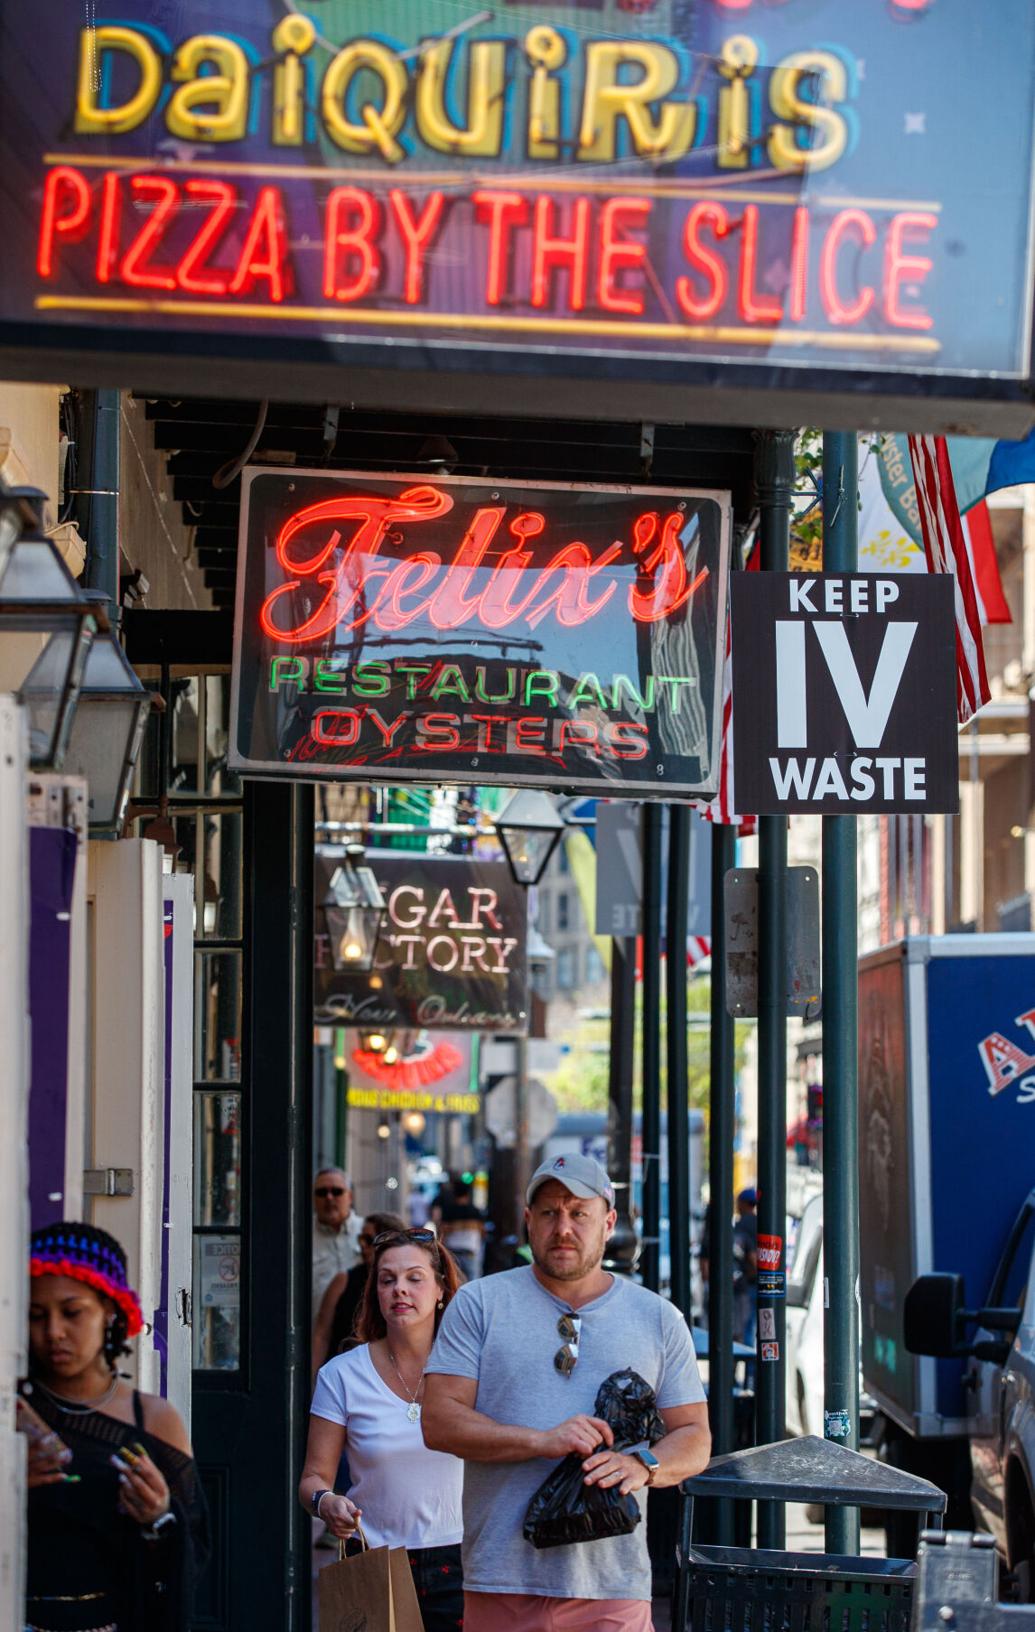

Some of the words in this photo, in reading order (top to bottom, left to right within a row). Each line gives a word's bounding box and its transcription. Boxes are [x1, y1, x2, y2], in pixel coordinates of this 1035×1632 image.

[37, 165, 285, 304] PIZZA
[323, 186, 444, 305] BY
[472, 189, 654, 315] THE
[676, 201, 939, 331] SLICE
[260, 485, 710, 643] Felix's
[788, 578, 901, 614] KEEP
[268, 655, 698, 715] RESTAURANT
[774, 619, 920, 749] IV
[311, 706, 651, 761] OYSTERS
[768, 756, 928, 801] WASTE
